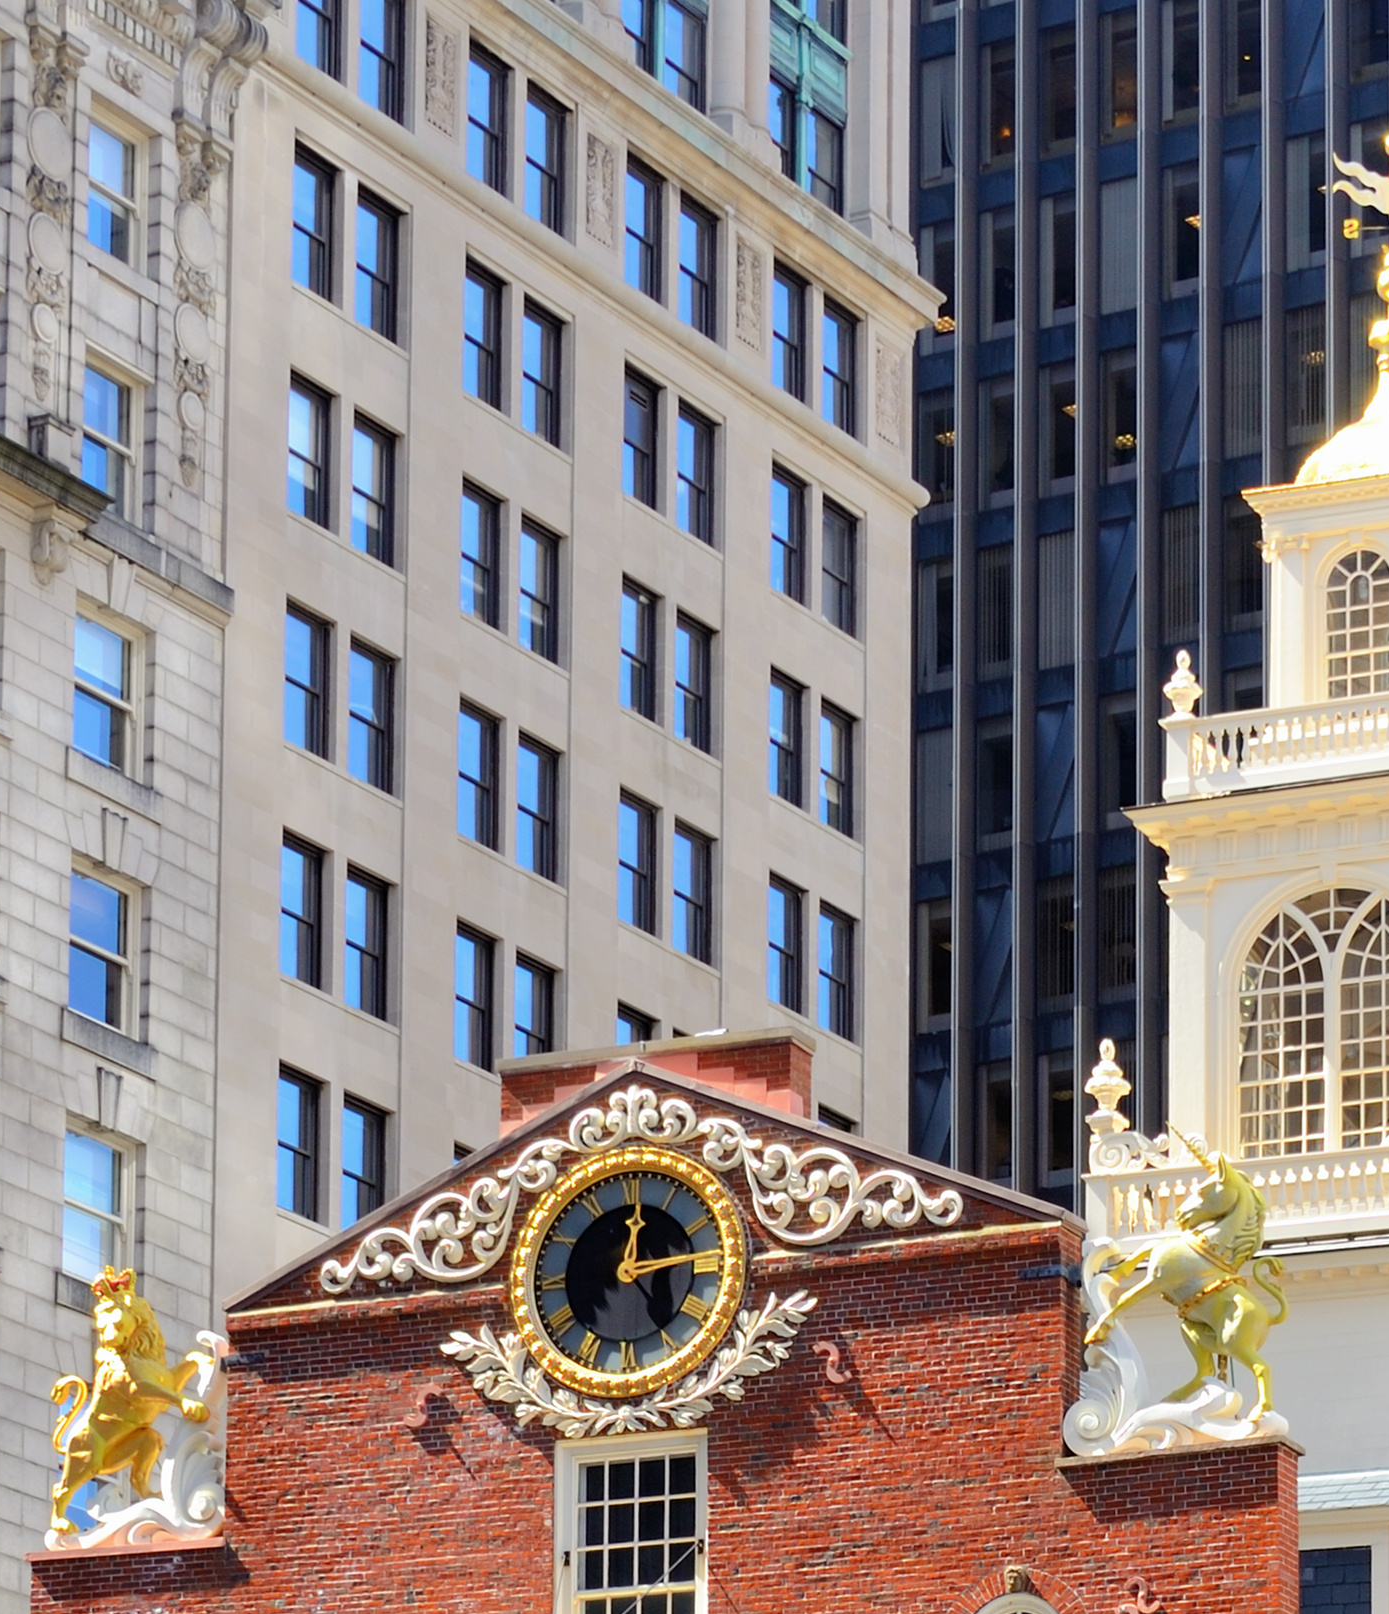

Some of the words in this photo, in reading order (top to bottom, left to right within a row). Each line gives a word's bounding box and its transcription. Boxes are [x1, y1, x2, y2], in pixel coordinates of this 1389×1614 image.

[622, 1180, 640, 1204] XII
[581, 1194, 605, 1220] XI
[686, 1216, 708, 1236] II
[551, 1231, 576, 1250] X
[694, 1257, 719, 1274] III
[542, 1273, 566, 1290] IX
[548, 1305, 577, 1338] VIII
[578, 1330, 601, 1364] VII
[661, 1329, 677, 1351] V
[620, 1341, 636, 1368] VI
